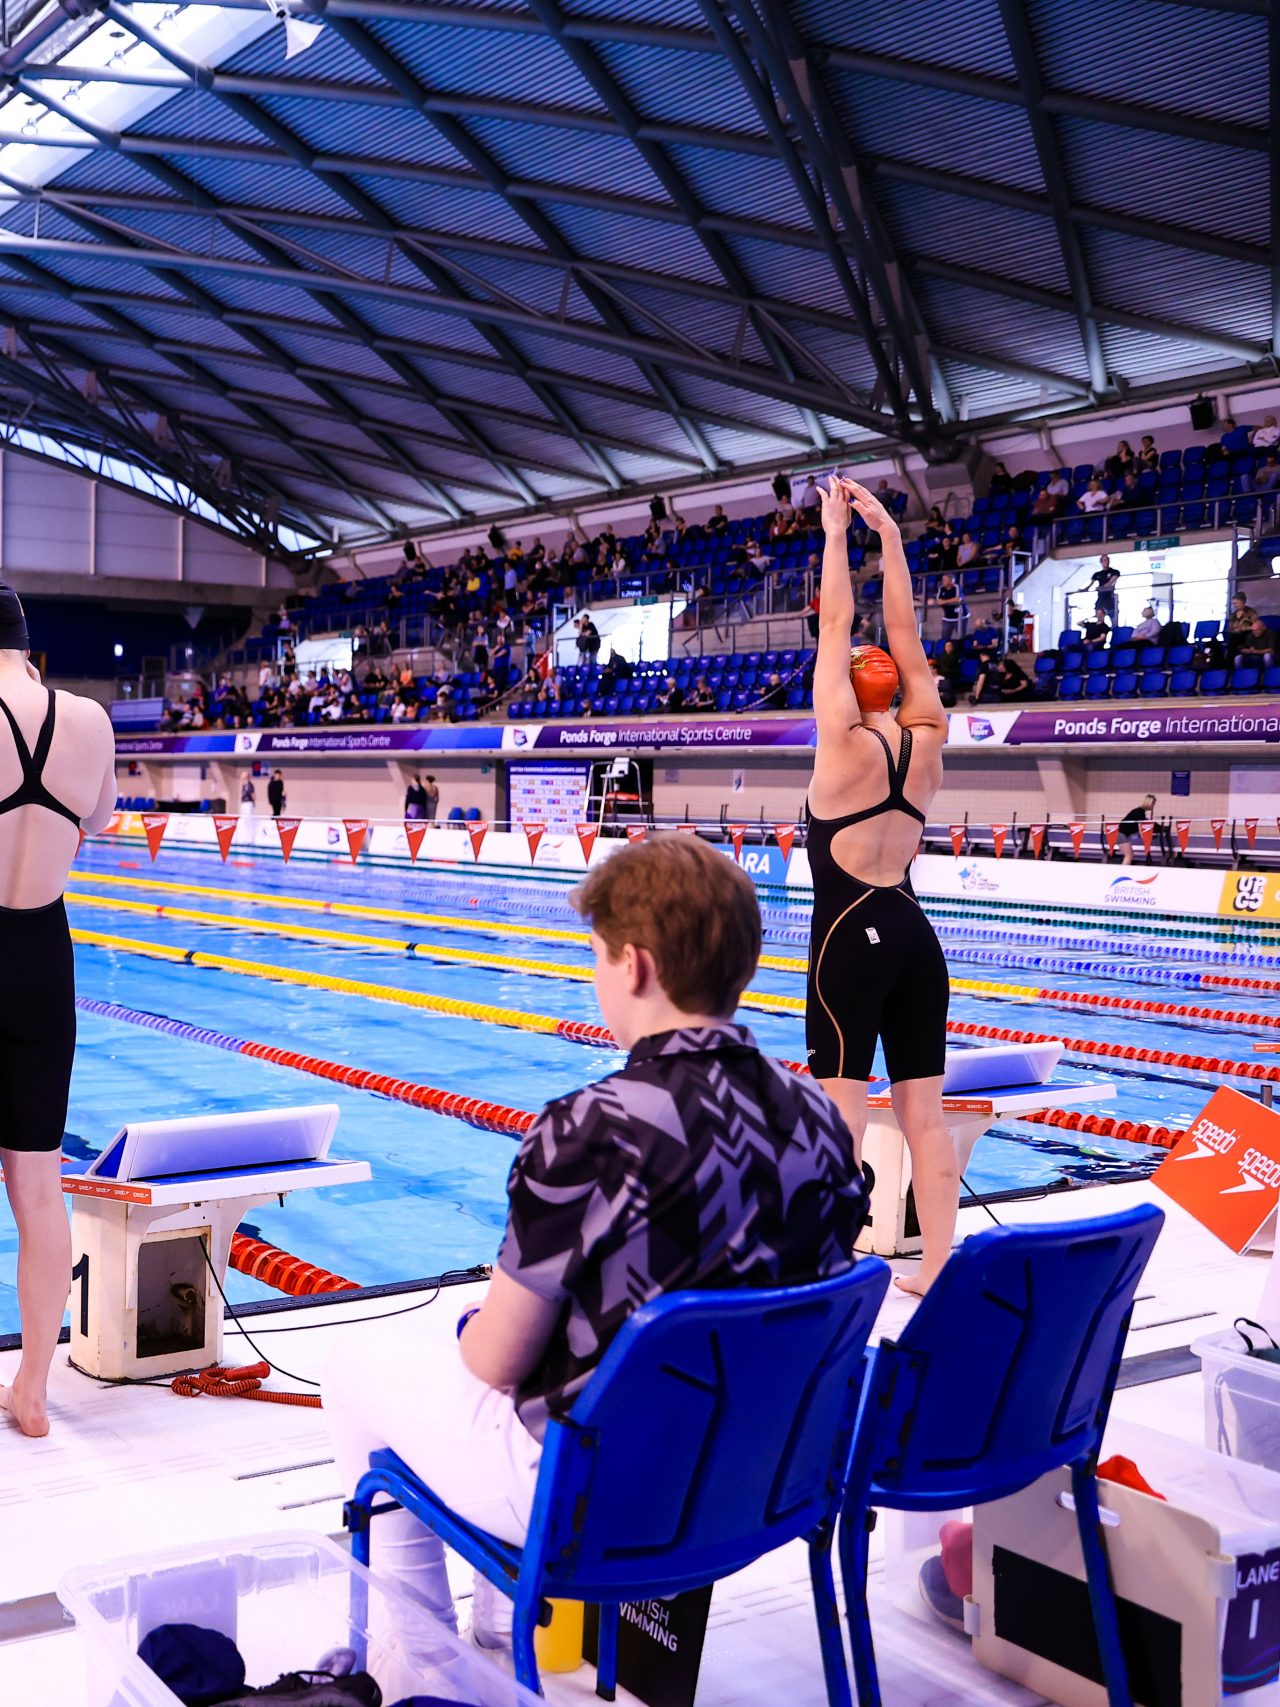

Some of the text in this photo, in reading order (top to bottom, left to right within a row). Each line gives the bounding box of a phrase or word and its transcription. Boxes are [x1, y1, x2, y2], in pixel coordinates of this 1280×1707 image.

[559, 726, 752, 746] Ponds Forge International Sports Centre
[1053, 713, 1280, 738] Ponds Forge Internationa
[1104, 894, 1156, 906] SWIMMING
[1113, 886, 1151, 896] BRITISH
[1191, 1118, 1237, 1154] speedo
[72, 1253, 89, 1338] 1
[1236, 1560, 1280, 1589] LANE
